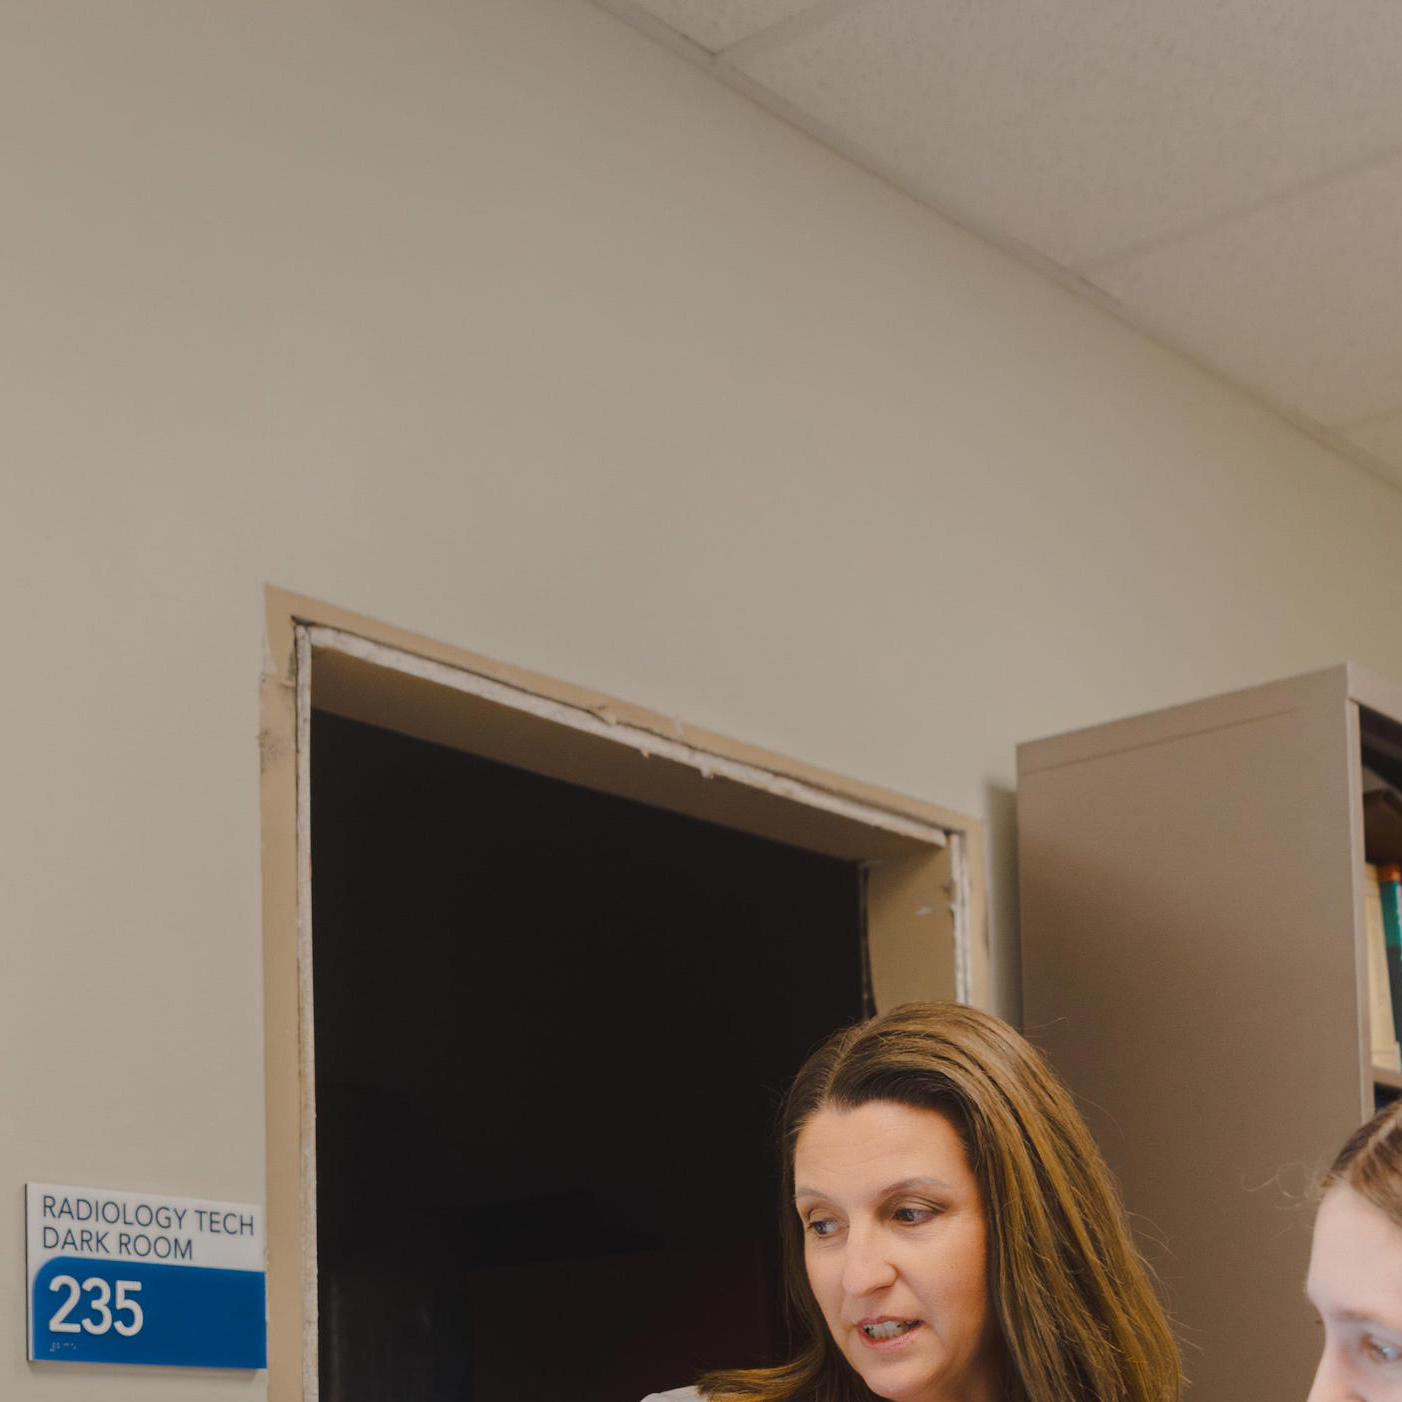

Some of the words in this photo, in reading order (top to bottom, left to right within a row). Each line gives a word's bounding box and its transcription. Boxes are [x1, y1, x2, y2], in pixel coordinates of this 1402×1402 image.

[42, 1194, 188, 1230] RADIOLOGY
[194, 1209, 254, 1237] TECH
[42, 1226, 111, 1255] DARK
[119, 1232, 193, 1261] ROOM
[48, 1274, 144, 1337] 235
